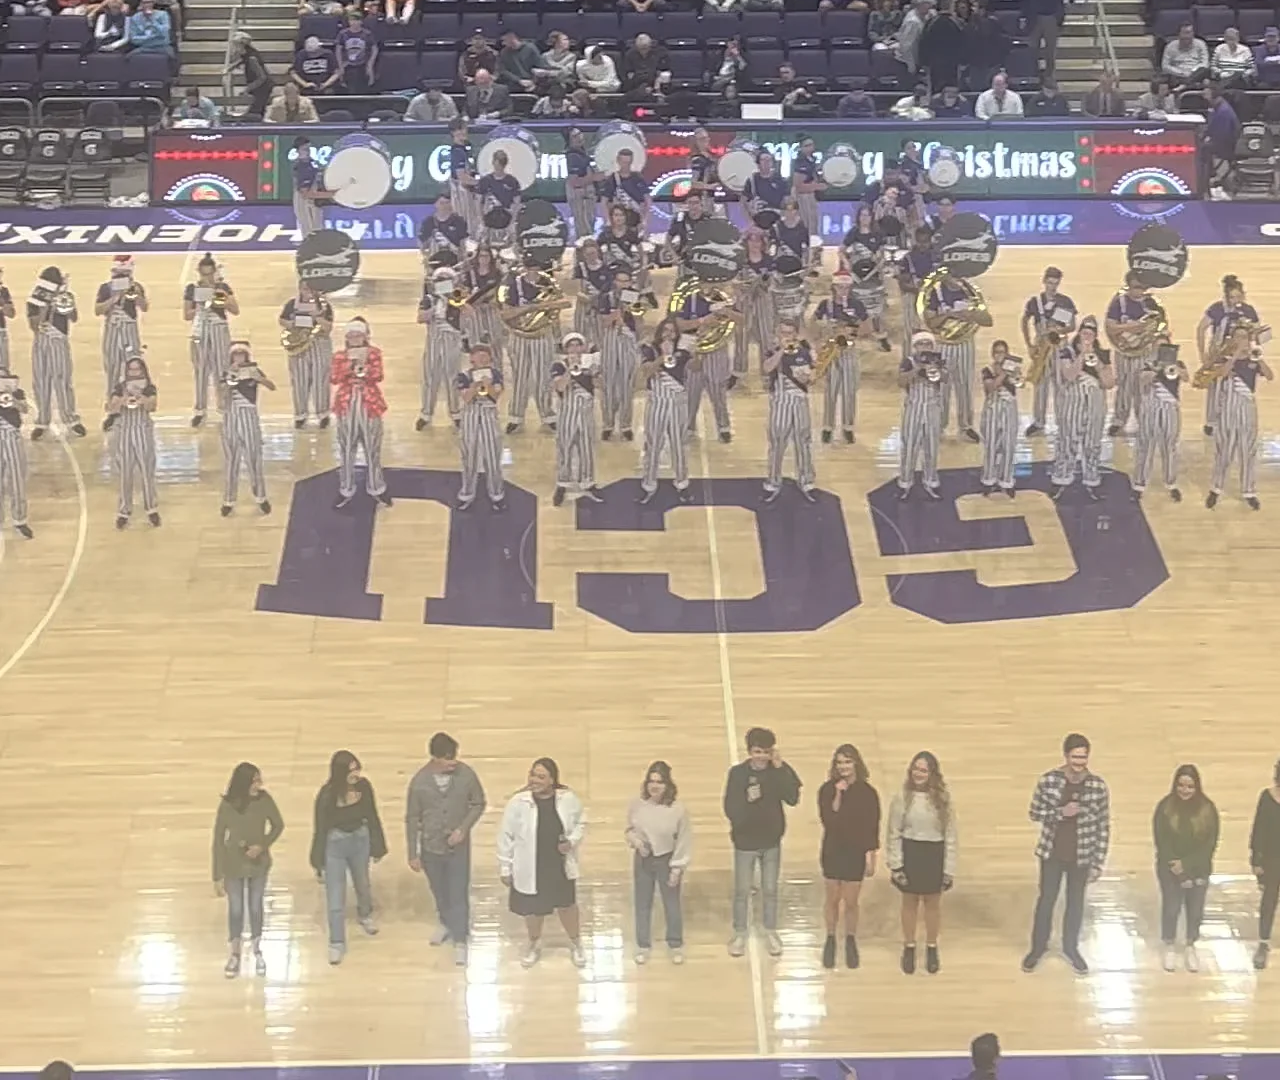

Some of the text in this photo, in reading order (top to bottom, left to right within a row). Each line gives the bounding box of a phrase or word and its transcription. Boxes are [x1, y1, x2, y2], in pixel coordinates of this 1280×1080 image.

[523, 238, 564, 248] LOPES
[692, 252, 738, 271] LOPES
[943, 252, 990, 263] LOPES
[302, 267, 354, 279] LOPES
[1133, 258, 1180, 277] LOPES
[254, 463, 1171, 634] GCU
